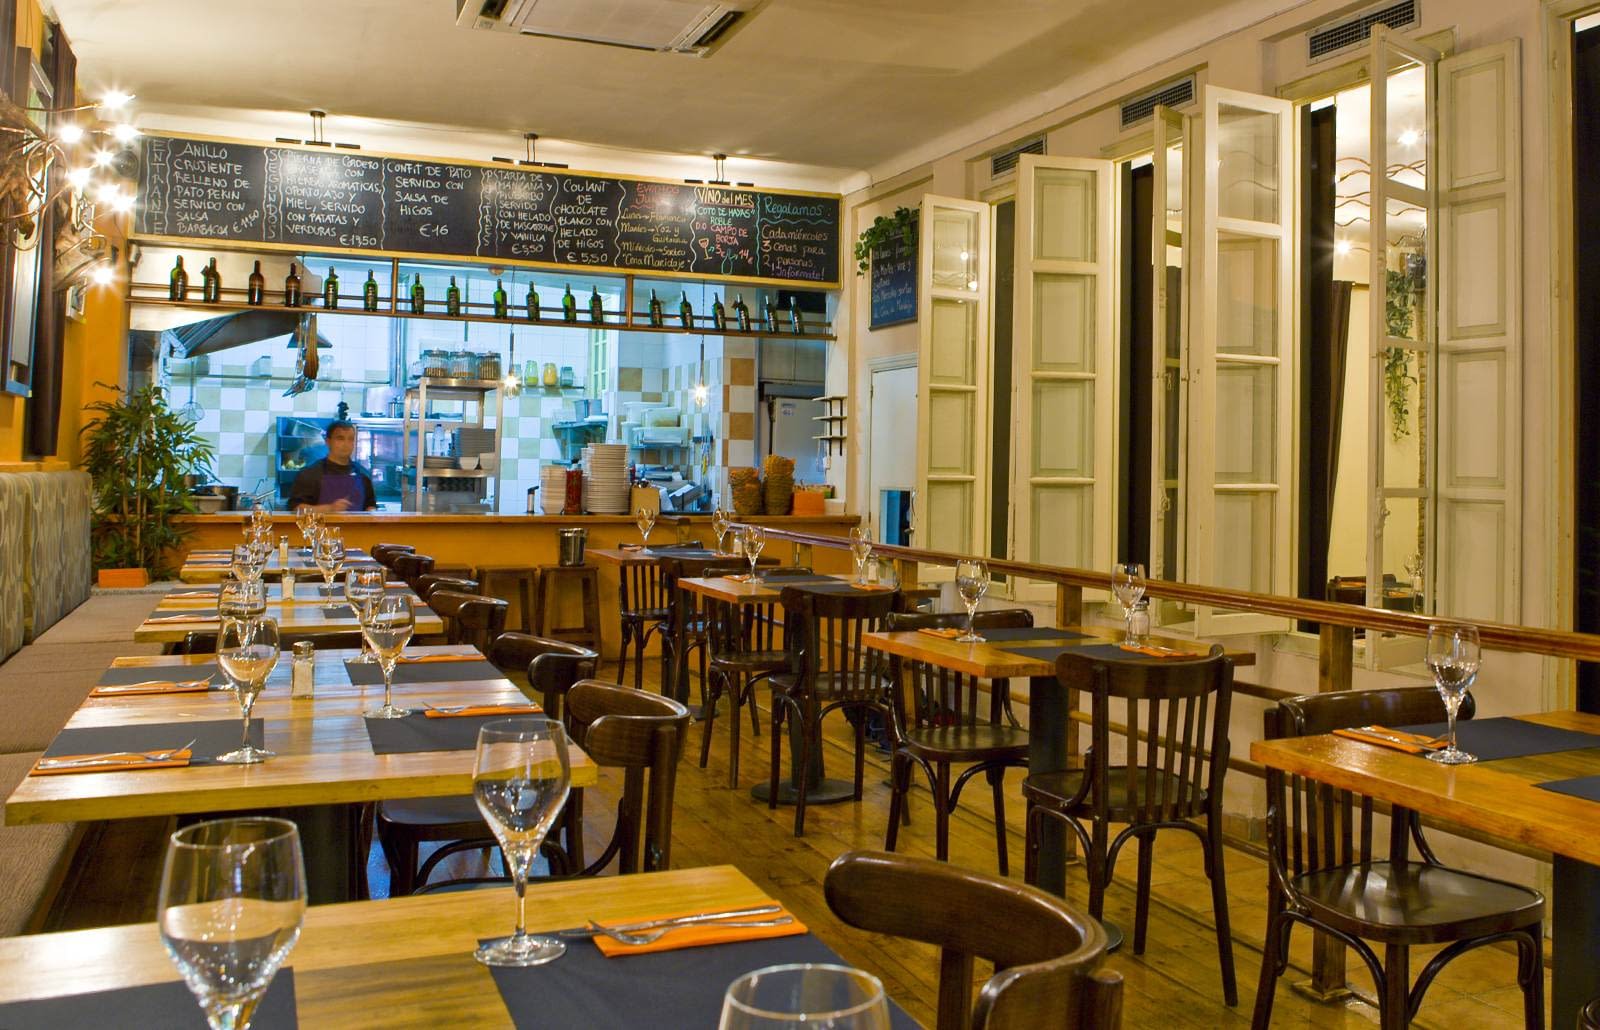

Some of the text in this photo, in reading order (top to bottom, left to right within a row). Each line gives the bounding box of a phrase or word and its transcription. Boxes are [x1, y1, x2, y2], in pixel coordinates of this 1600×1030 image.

[176, 142, 228, 160] ANILLO
[174, 159, 243, 175] CRUJIENTE
[344, 168, 365, 178] CON
[387, 162, 472, 179] CONFIT DE PATO
[173, 171, 250, 189] RELLENO DE
[497, 170, 543, 182] TARTA DE
[395, 176, 464, 190] SERVIDO CON
[174, 185, 240, 200] PATO PEKIN
[348, 192, 357, 203] Y
[395, 191, 449, 205] SALSA DE
[174, 199, 246, 212] SERVIDO CON
[499, 200, 538, 211] SERVIDO
[576, 194, 593, 206] DE
[734, 193, 755, 207] MES
[320, 200, 366, 214] SERVIDO
[400, 204, 433, 216] HIGOS
[554, 203, 609, 216] CHOCOLATE
[718, 207, 728, 217] DE
[176, 211, 209, 222] SALSA
[287, 211, 360, 227] CON PATATAS Y
[499, 210, 551, 222] CON HELADO
[557, 216, 613, 227] BLANCO CON
[710, 216, 733, 226] ROBLE
[177, 221, 228, 236] BARBACOA
[286, 224, 337, 237] VERDURAS
[500, 220, 511, 230] DE
[710, 225, 737, 235] CAMPO
[738, 228, 749, 238] DE
[500, 231, 508, 242] Y
[560, 227, 598, 238] HELADO
[556, 239, 604, 249] DE HIGOS
[760, 239, 771, 253] 3
[762, 254, 771, 267] 2
